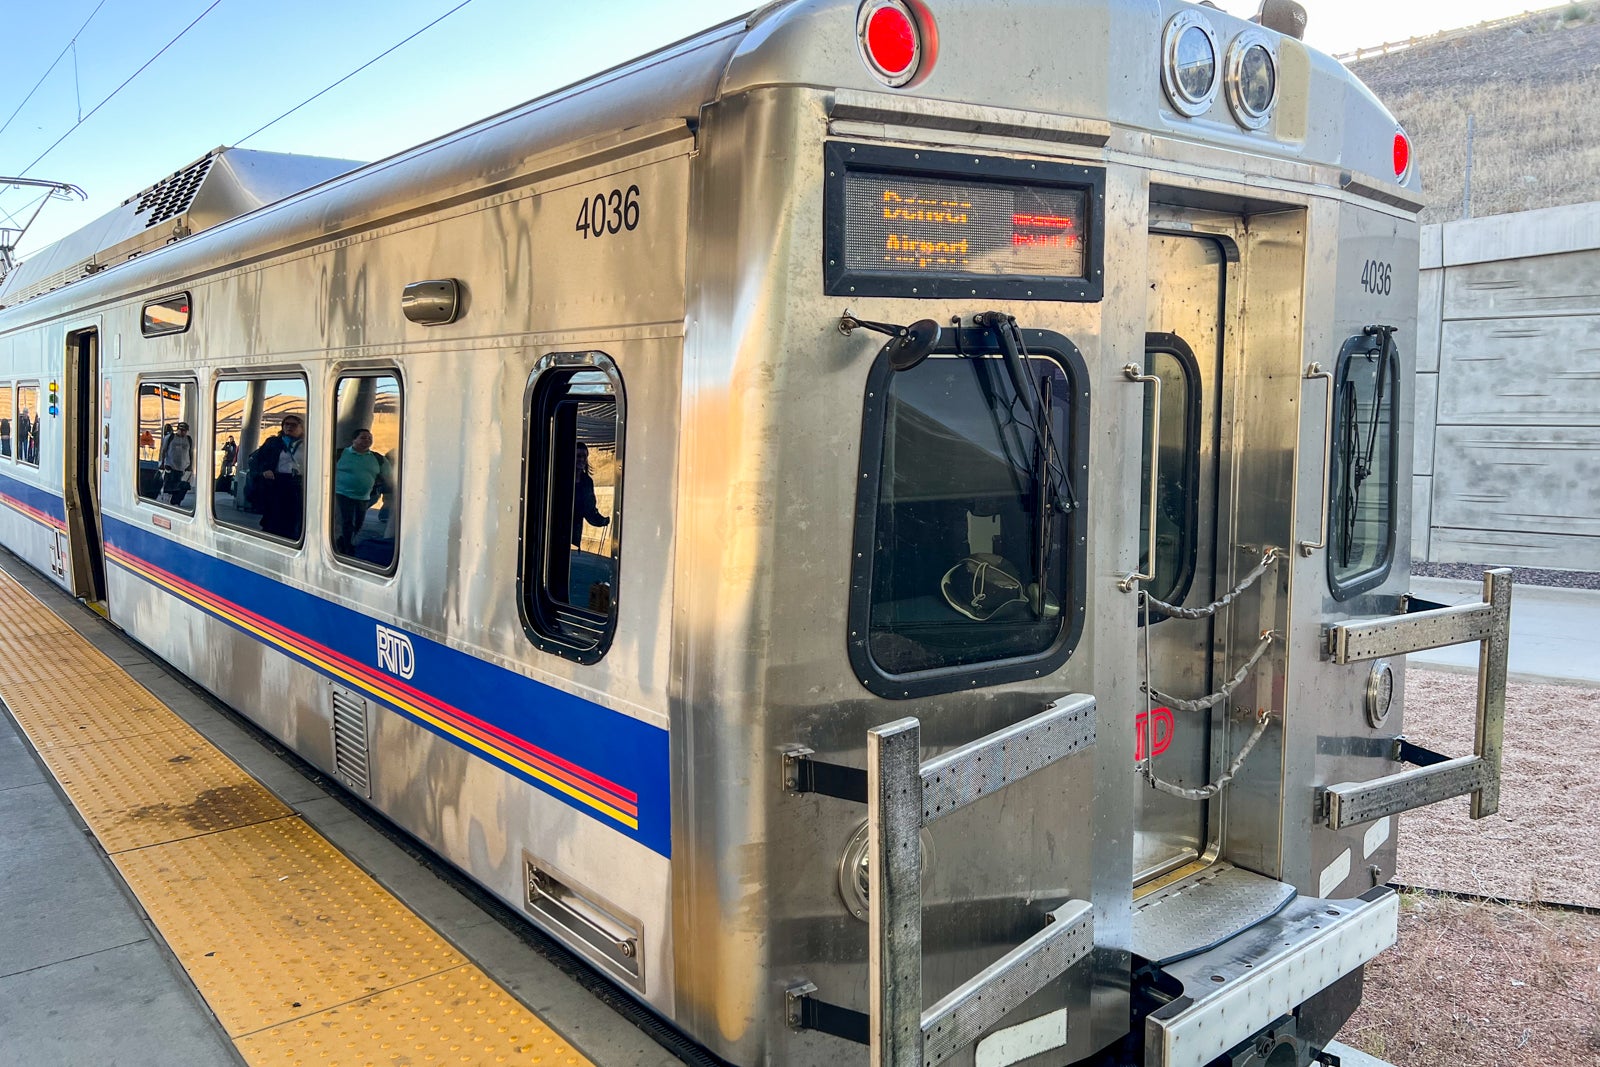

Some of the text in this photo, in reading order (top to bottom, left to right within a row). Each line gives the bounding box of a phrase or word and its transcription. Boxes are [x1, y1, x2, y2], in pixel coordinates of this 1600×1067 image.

[576, 184, 640, 239] 4036
[884, 233, 969, 267] Airport
[1361, 259, 1391, 296] 4036
[376, 623, 415, 680] RTD
[1134, 706, 1175, 761] TD
